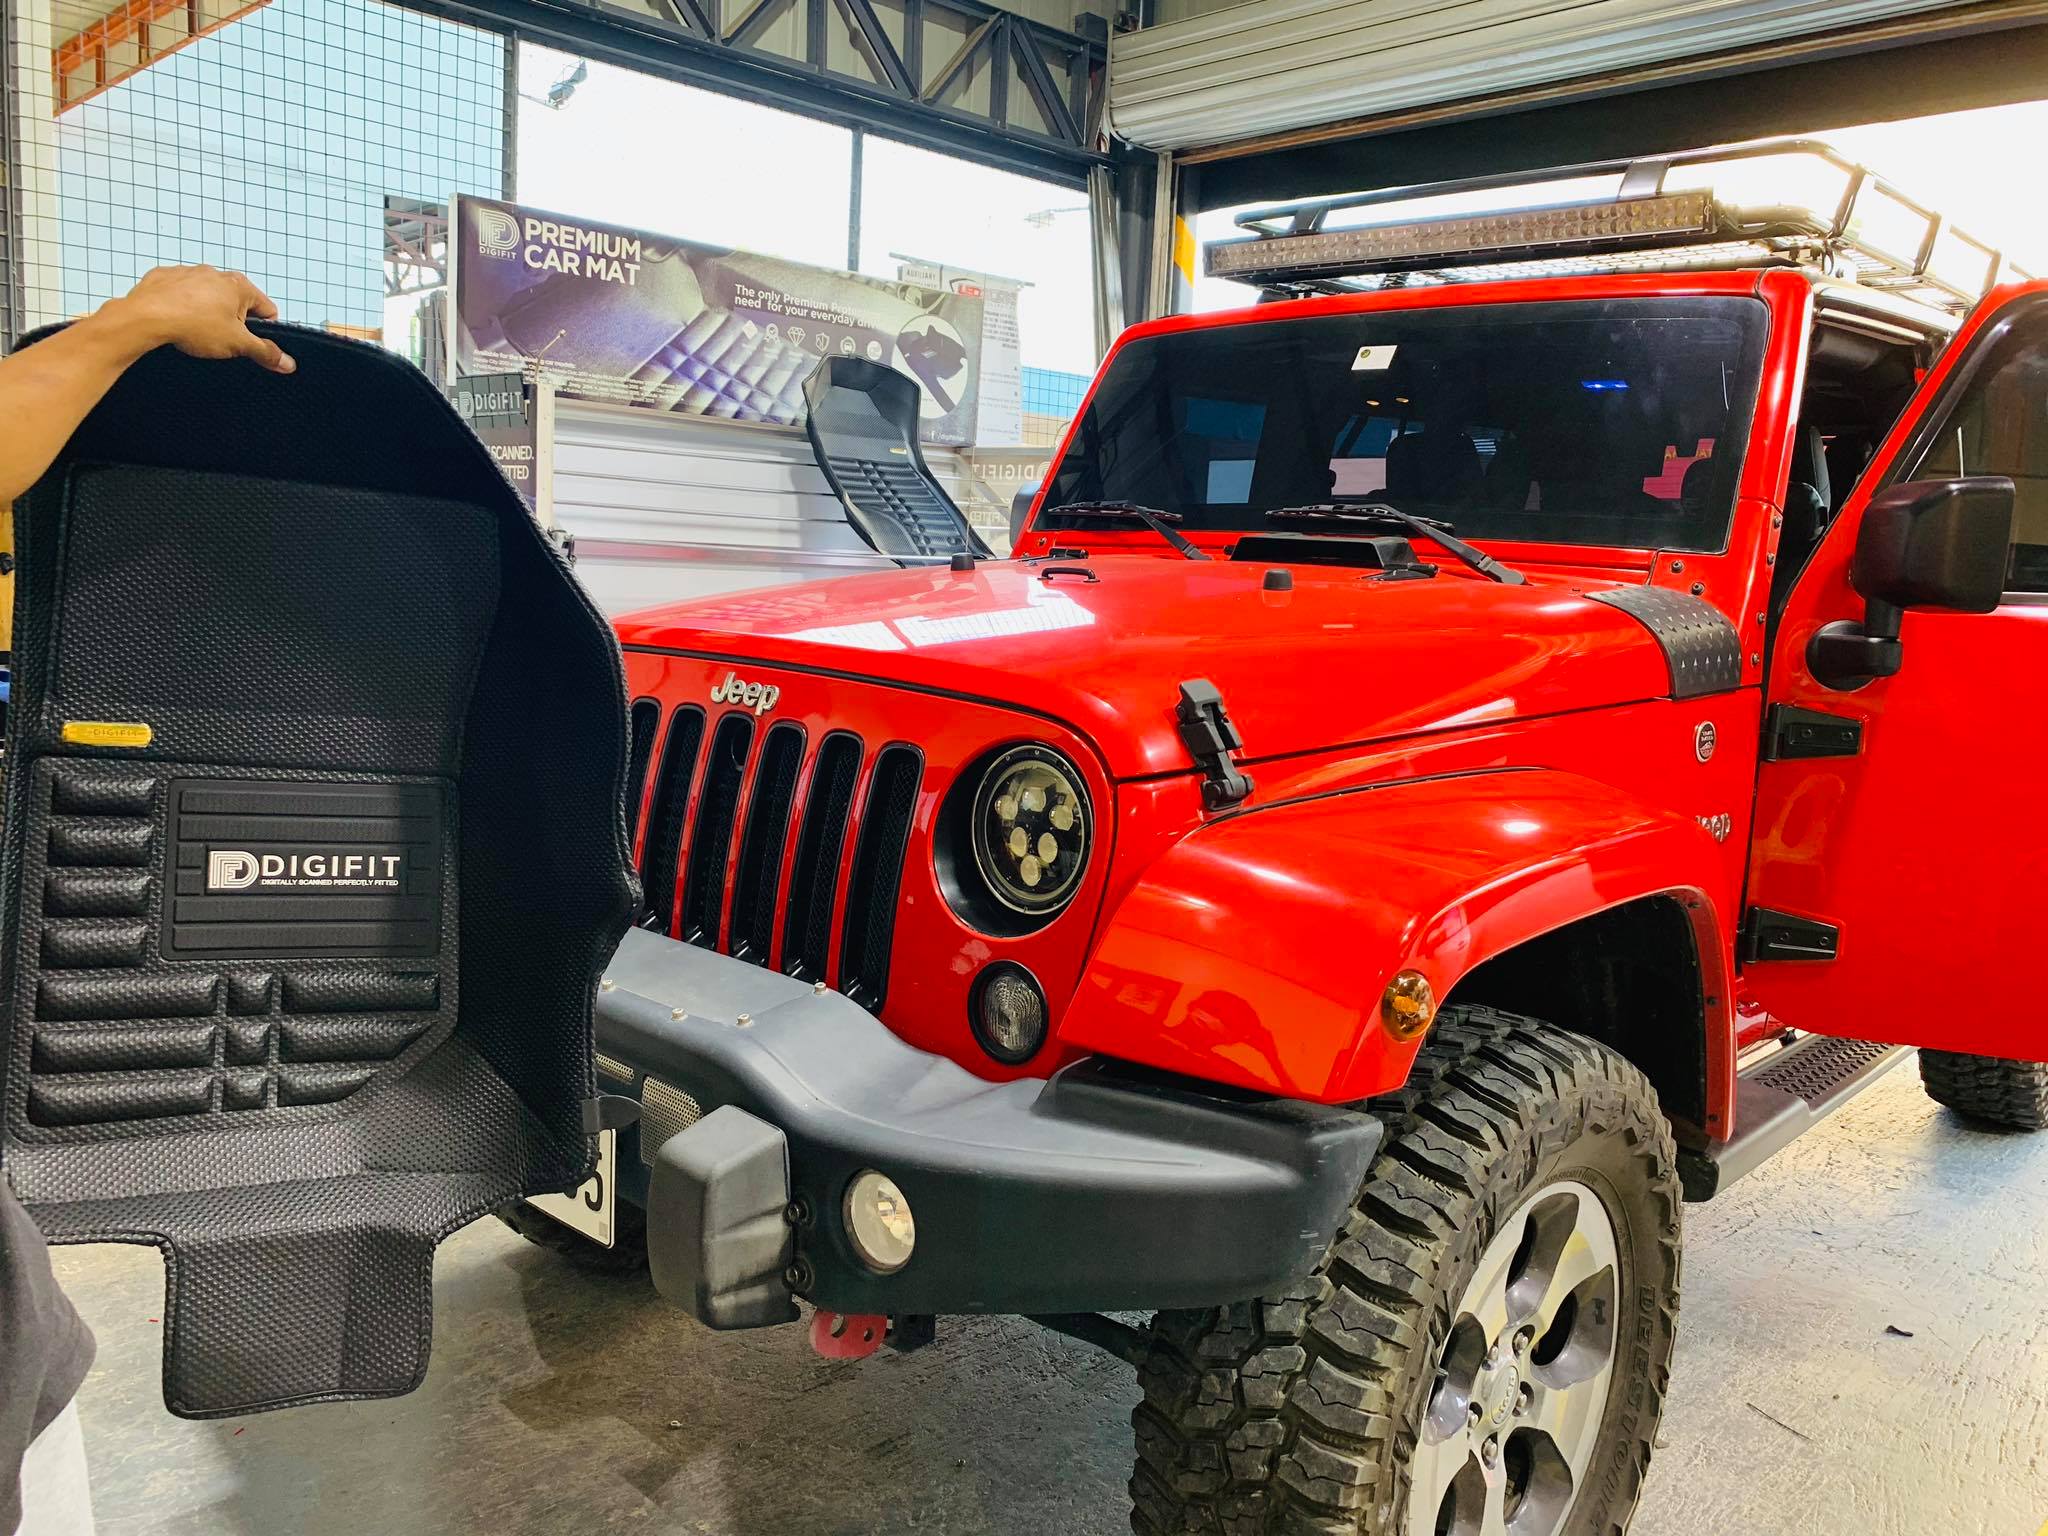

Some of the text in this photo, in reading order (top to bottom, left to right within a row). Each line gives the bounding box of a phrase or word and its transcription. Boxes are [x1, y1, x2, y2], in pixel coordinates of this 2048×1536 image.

[525, 217, 641, 262] PREMIUM
[479, 246, 517, 260] DIGIFIT
[524, 244, 641, 286] CAR MAT
[735, 283, 755, 298] The
[758, 290, 781, 302] only
[783, 293, 828, 310] Premium
[734, 296, 762, 308] need
[767, 301, 783, 313] for
[785, 305, 809, 319] your
[810, 310, 855, 328] everyday
[475, 391, 522, 411] DIGIFIT
[490, 445, 535, 460] SCANNED.
[710, 671, 780, 717] Jeep
[261, 854, 401, 877] DIGIFIT
[261, 878, 400, 887] DIGITALLY SCANNED PERFECTLY FITTED
